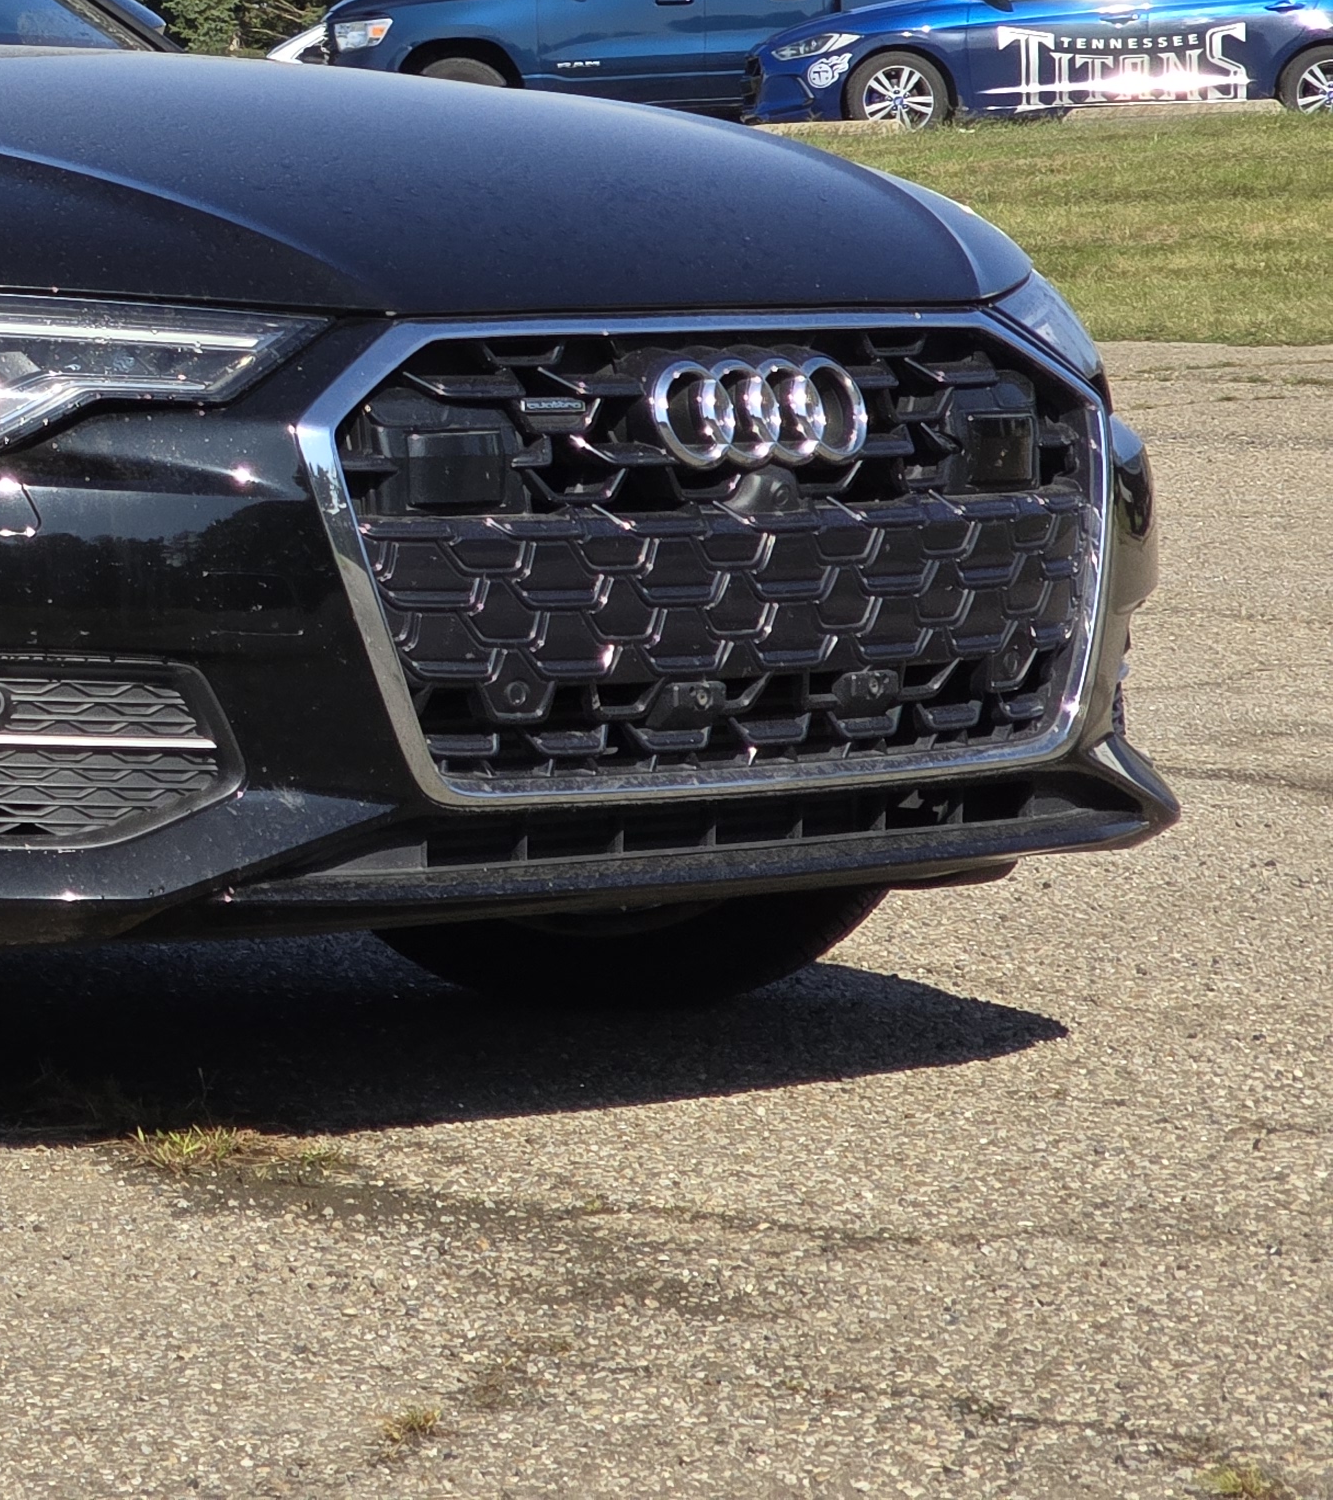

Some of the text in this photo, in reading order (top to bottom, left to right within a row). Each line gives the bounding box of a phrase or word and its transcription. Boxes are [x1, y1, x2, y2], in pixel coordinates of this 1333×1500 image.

[1059, 33, 1200, 49] TENNESSEE
[556, 60, 601, 69] RAM
[997, 22, 1247, 113] TITANS
[526, 400, 582, 409] quattro
